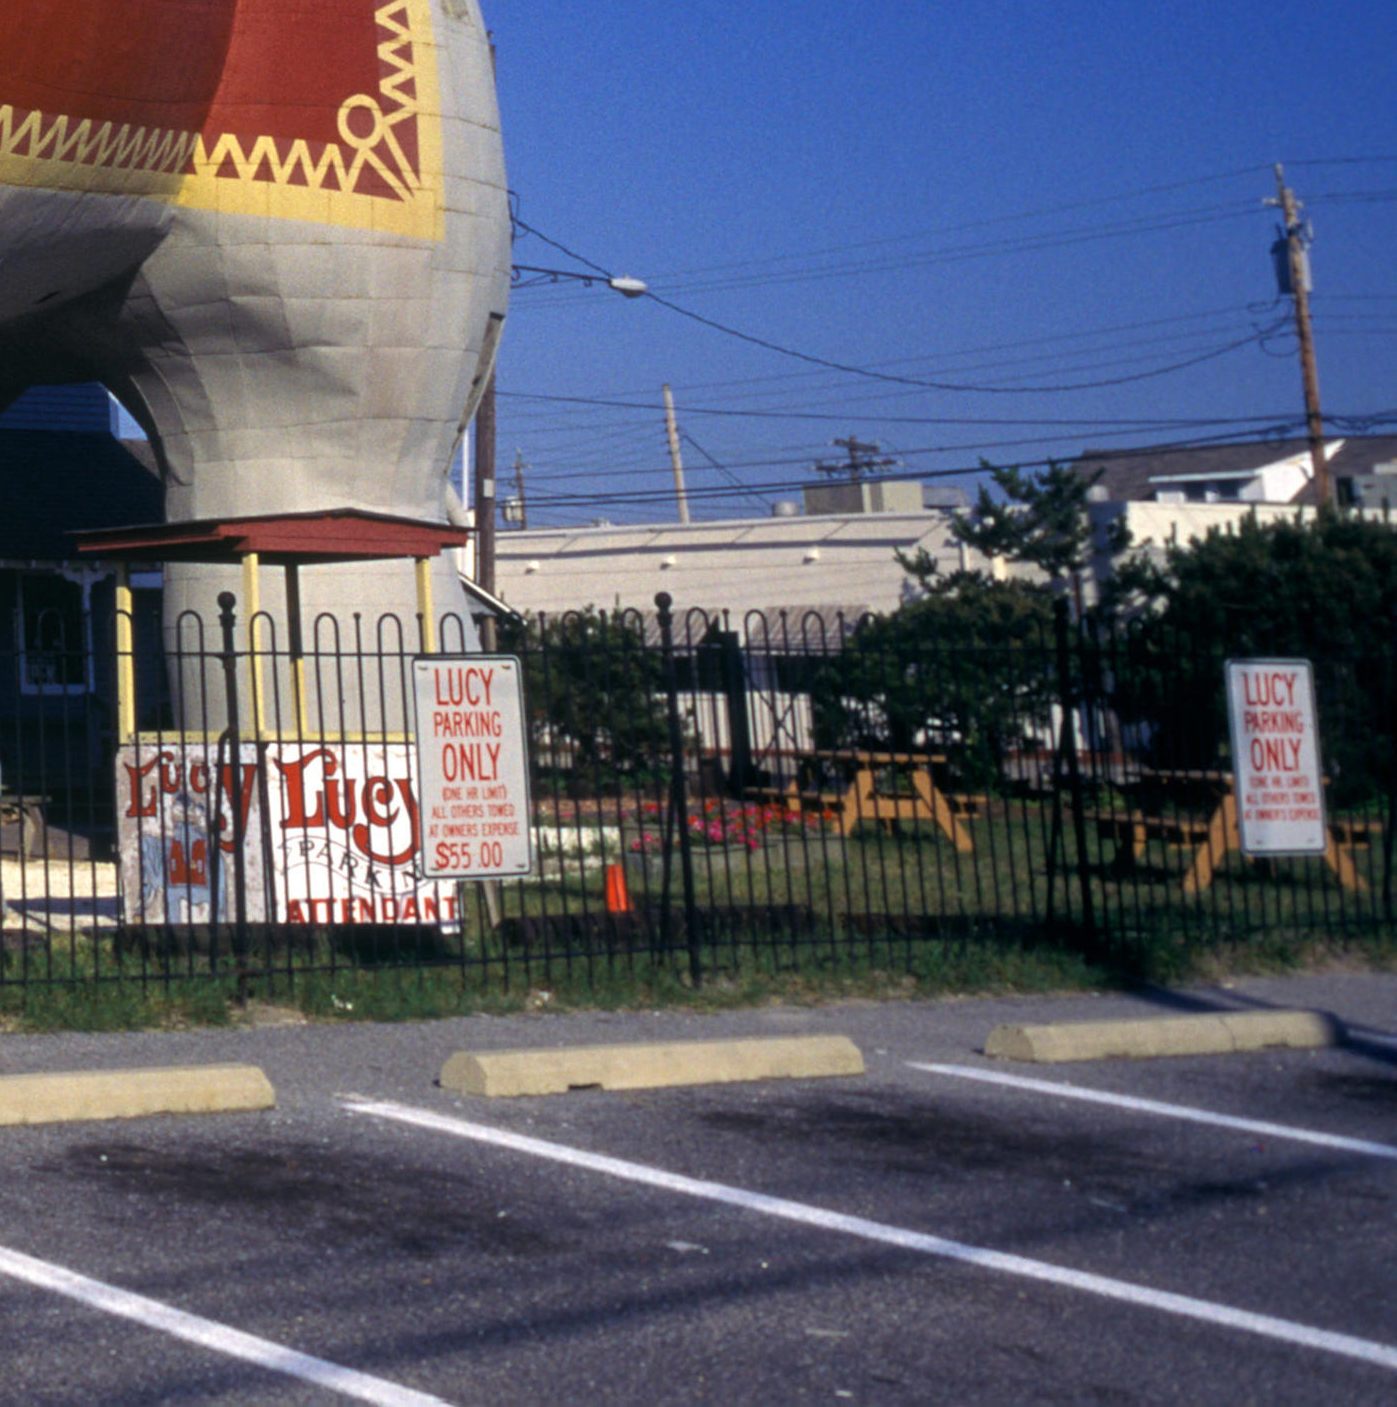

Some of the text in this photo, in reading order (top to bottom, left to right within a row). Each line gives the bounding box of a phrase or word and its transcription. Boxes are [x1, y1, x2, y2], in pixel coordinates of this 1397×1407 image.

[435, 667, 493, 707] LUCY
[1244, 672, 1295, 706] LUCY
[433, 711, 502, 738] PARKING
[1244, 711, 1304, 734] PARKING
[442, 742, 501, 782] ONLY
[1251, 738, 1301, 772] ONLY
[288, 897, 457, 924] ATTENDANT
